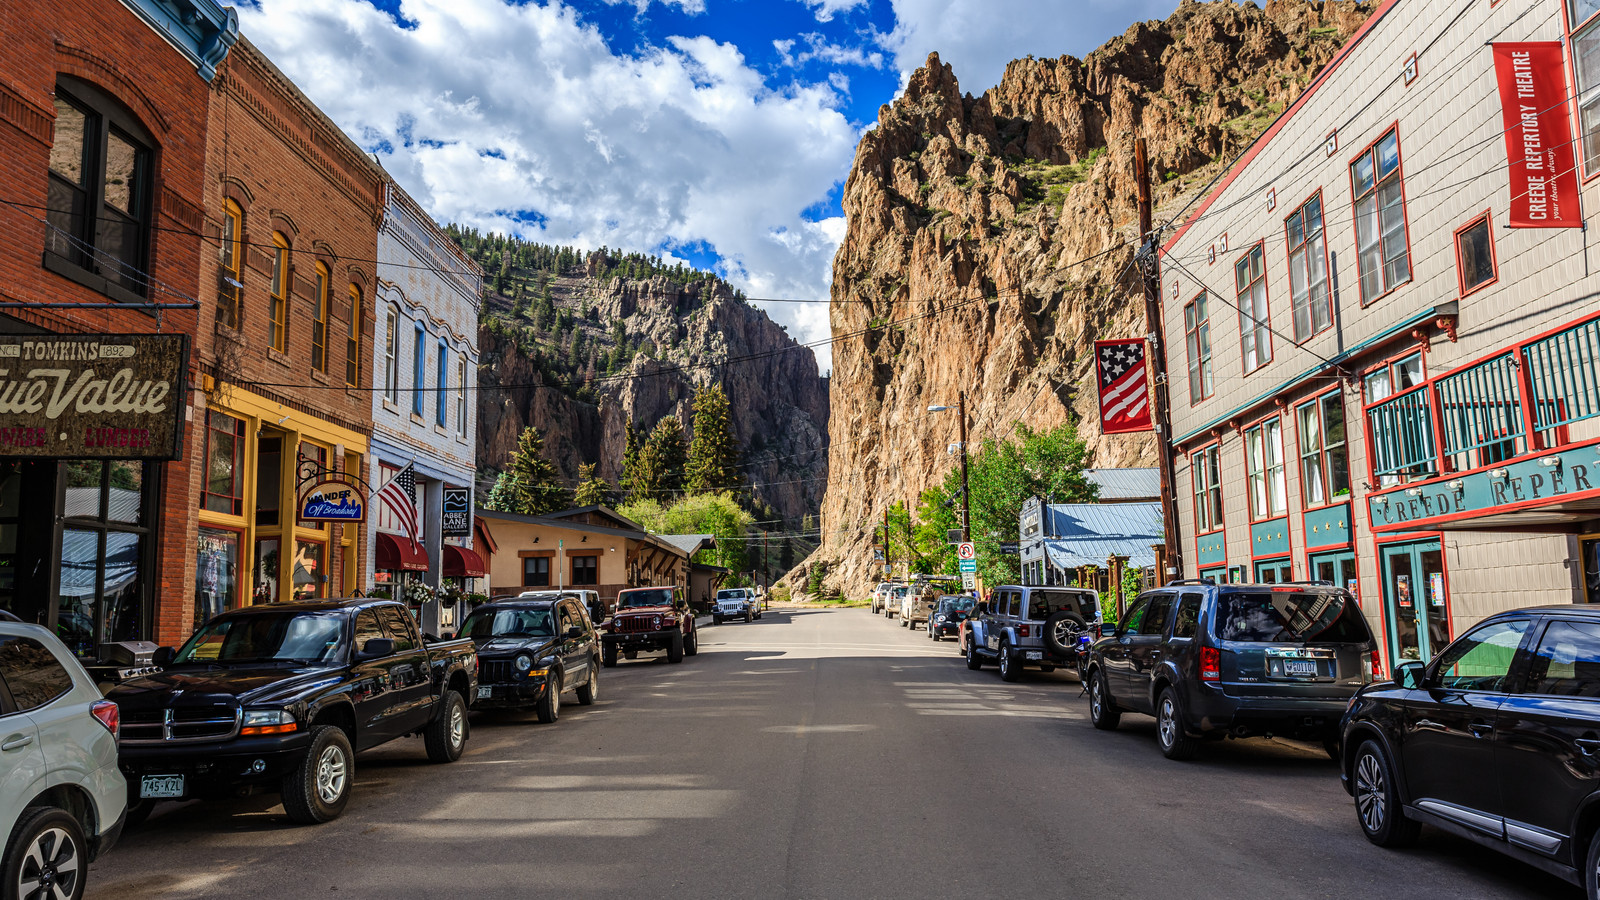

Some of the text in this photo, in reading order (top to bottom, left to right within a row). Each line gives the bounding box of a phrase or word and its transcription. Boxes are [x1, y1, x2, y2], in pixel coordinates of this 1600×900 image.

[1512, 51, 1547, 220] CREEDE REPERTORY THEATRE
[1552, 202, 1563, 221] your
[23, 341, 99, 361] TOMKINS
[103, 346, 124, 357] 1892
[0, 368, 170, 419] ue Value
[0, 428, 150, 447] WARE LUMBER
[307, 490, 352, 504] WANDER
[1383, 490, 1466, 523] CREEDE
[308, 504, 358, 517] Off Broadway
